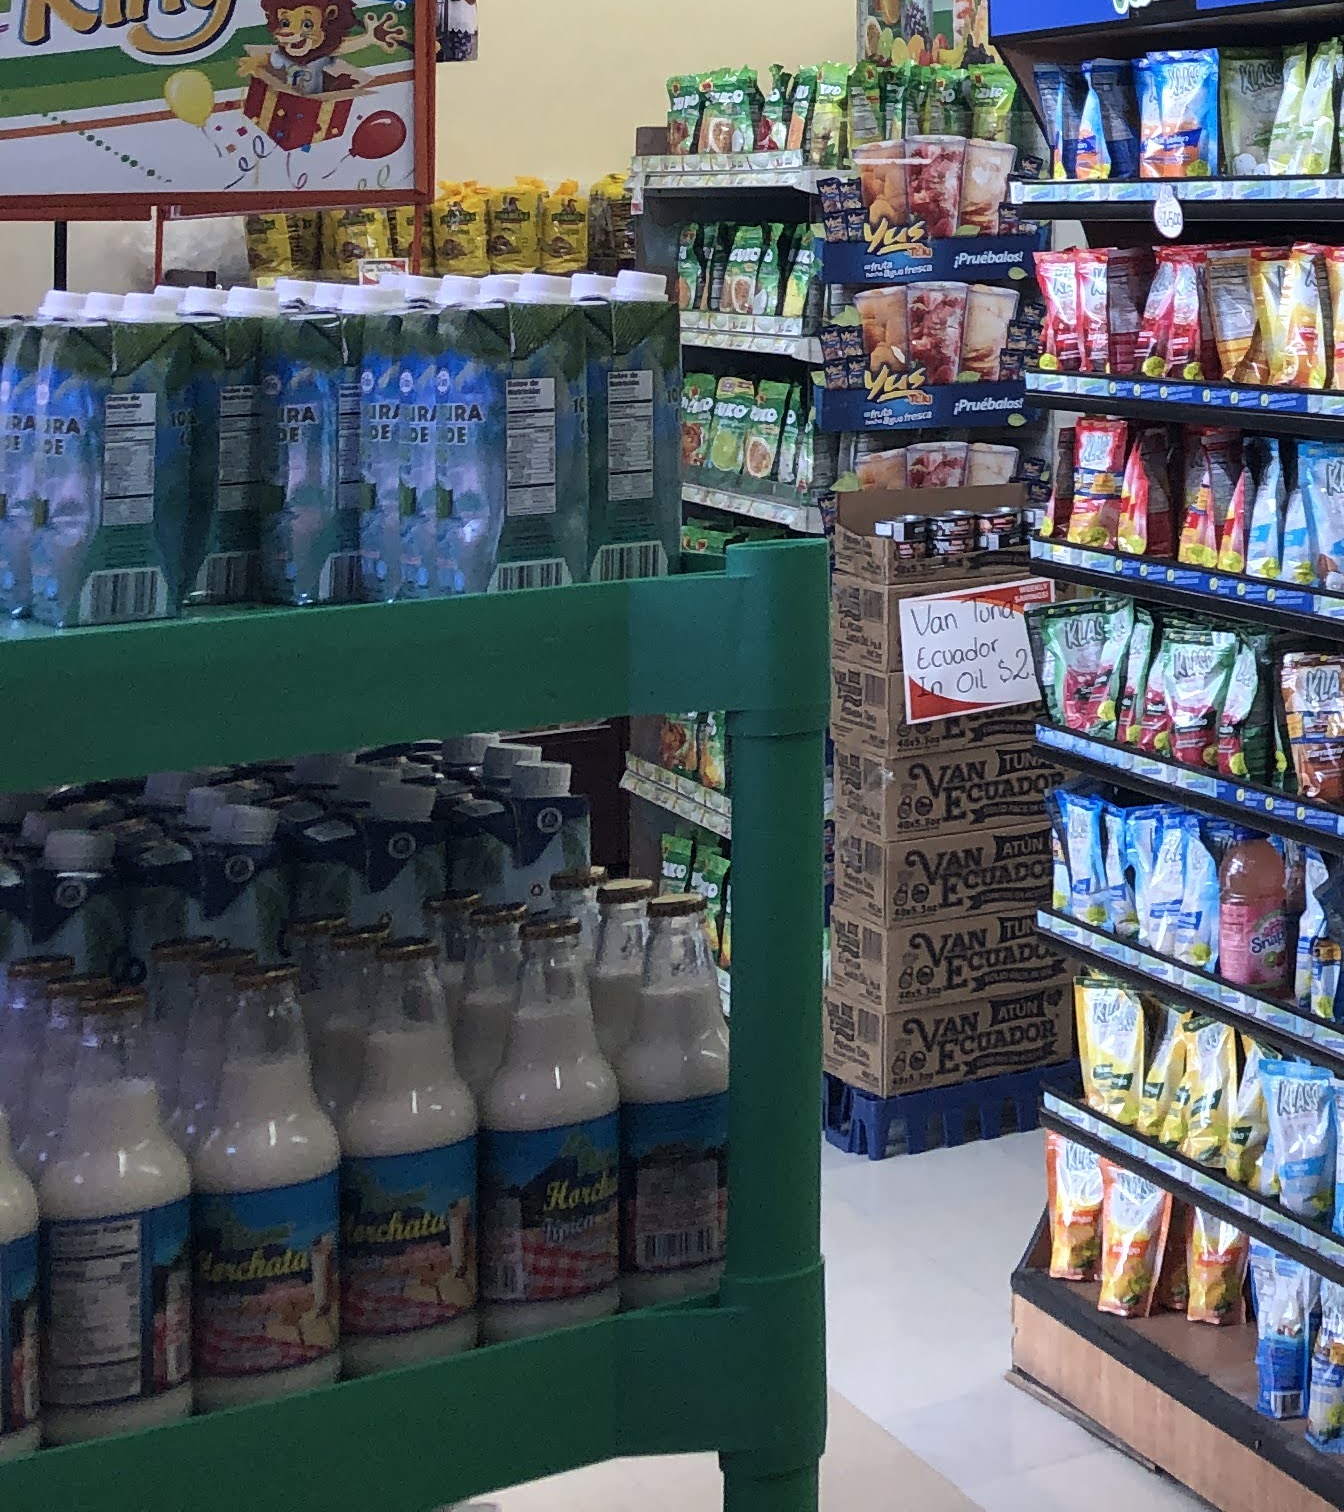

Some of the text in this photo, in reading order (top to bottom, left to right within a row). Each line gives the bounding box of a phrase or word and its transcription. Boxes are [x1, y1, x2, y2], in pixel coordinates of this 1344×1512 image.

[1240, 62, 1282, 95] KLASS
[953, 251, 1023, 269] ¡Pruébalos!
[953, 397, 1024, 415] ¡Pruébalos!
[911, 595, 1015, 636] Van Tuna
[917, 637, 998, 670] Ecuador
[917, 676, 943, 697] In
[957, 668, 988, 693] Oil
[908, 760, 988, 799] VAN
[943, 771, 1065, 822] ECUADOR
[903, 1012, 979, 1053] VAN
[936, 1020, 1058, 1074] ECUADOR
